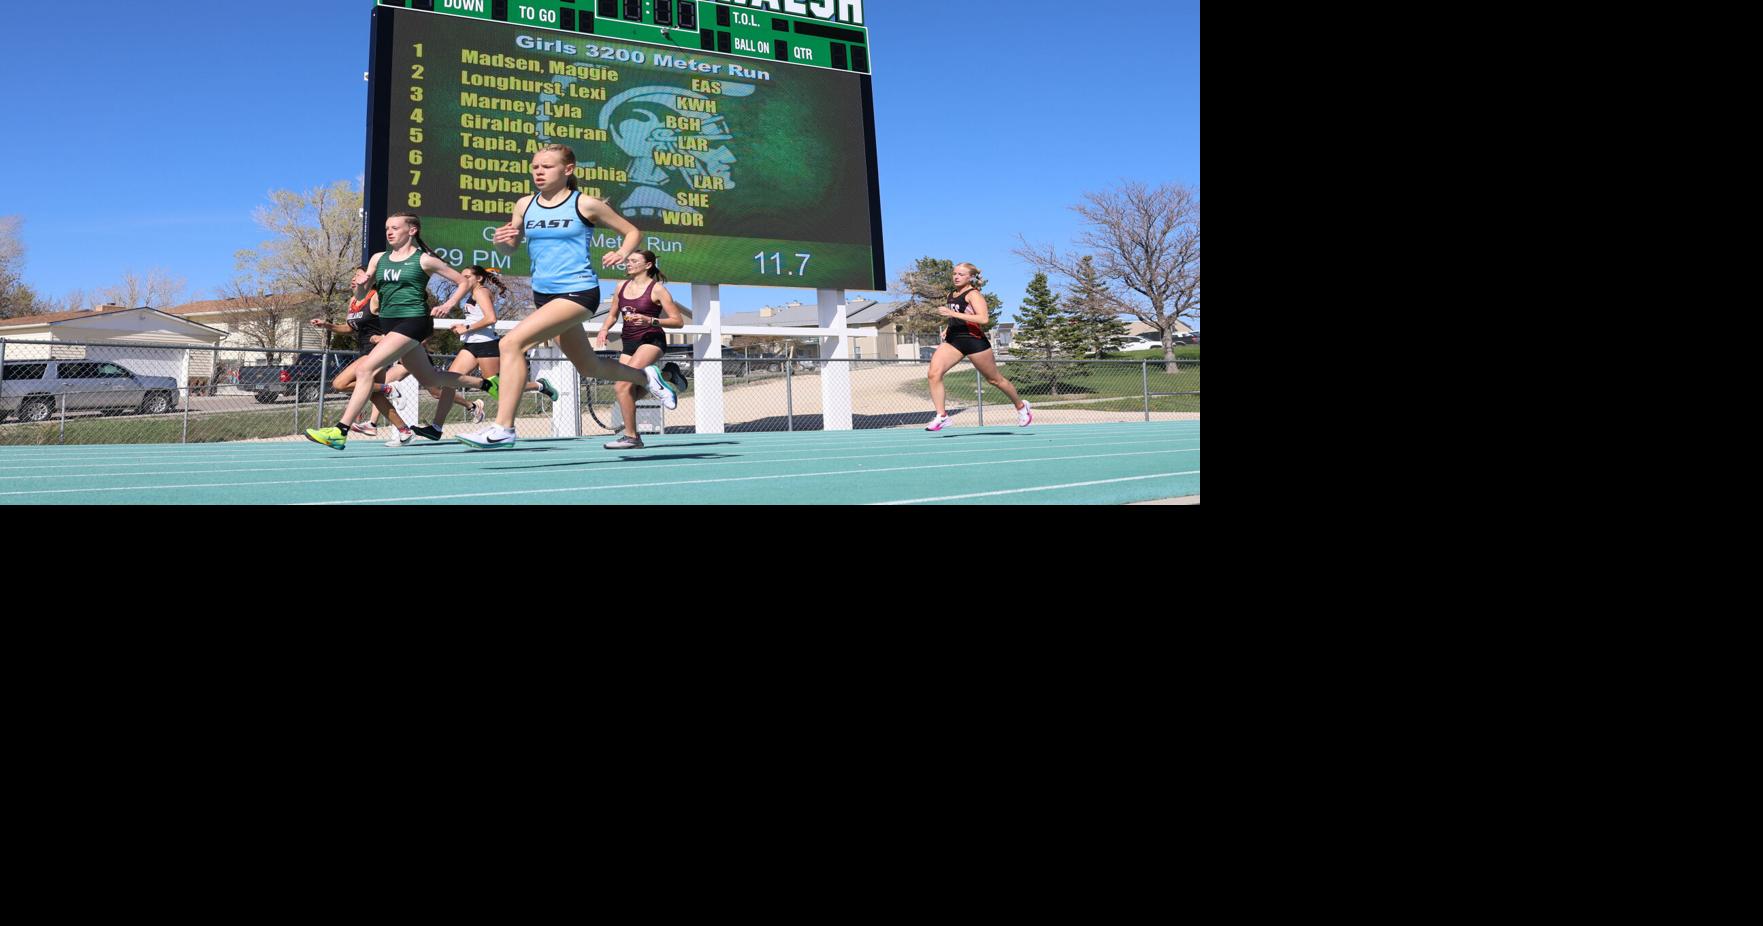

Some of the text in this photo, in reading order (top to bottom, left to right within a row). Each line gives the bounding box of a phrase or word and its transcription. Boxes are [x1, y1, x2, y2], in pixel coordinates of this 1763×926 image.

[519, 6, 556, 23] TO GO
[732, 12, 760, 27] T.O.L.
[515, 35, 770, 81] Girls 3200 Meter Run
[734, 38, 770, 54] BALL ON
[793, 47, 813, 60] QTR
[412, 43, 722, 95] 1 Madsen, Maggie EAS
[411, 64, 717, 113] 2 Longhurst, Lexi KWH
[410, 86, 701, 131] 3 Marney, Lyla BGH
[410, 107, 708, 152] 4 Giraldo, Keiran LAR
[409, 127, 424, 143] 5
[460, 132, 521, 153] Tapia,
[653, 151, 696, 168] WOR
[408, 149, 423, 165] 6
[574, 165, 628, 183] ophia
[693, 175, 725, 190] LAR
[410, 170, 423, 185] 7
[676, 192, 709, 208] SHE
[407, 191, 422, 208] 8
[662, 211, 704, 227] WOR
[525, 219, 574, 229] EAST
[473, 249, 512, 269] PM
[647, 236, 683, 253] Run
[383, 268, 402, 282] KW
[754, 250, 811, 276] 11.7
